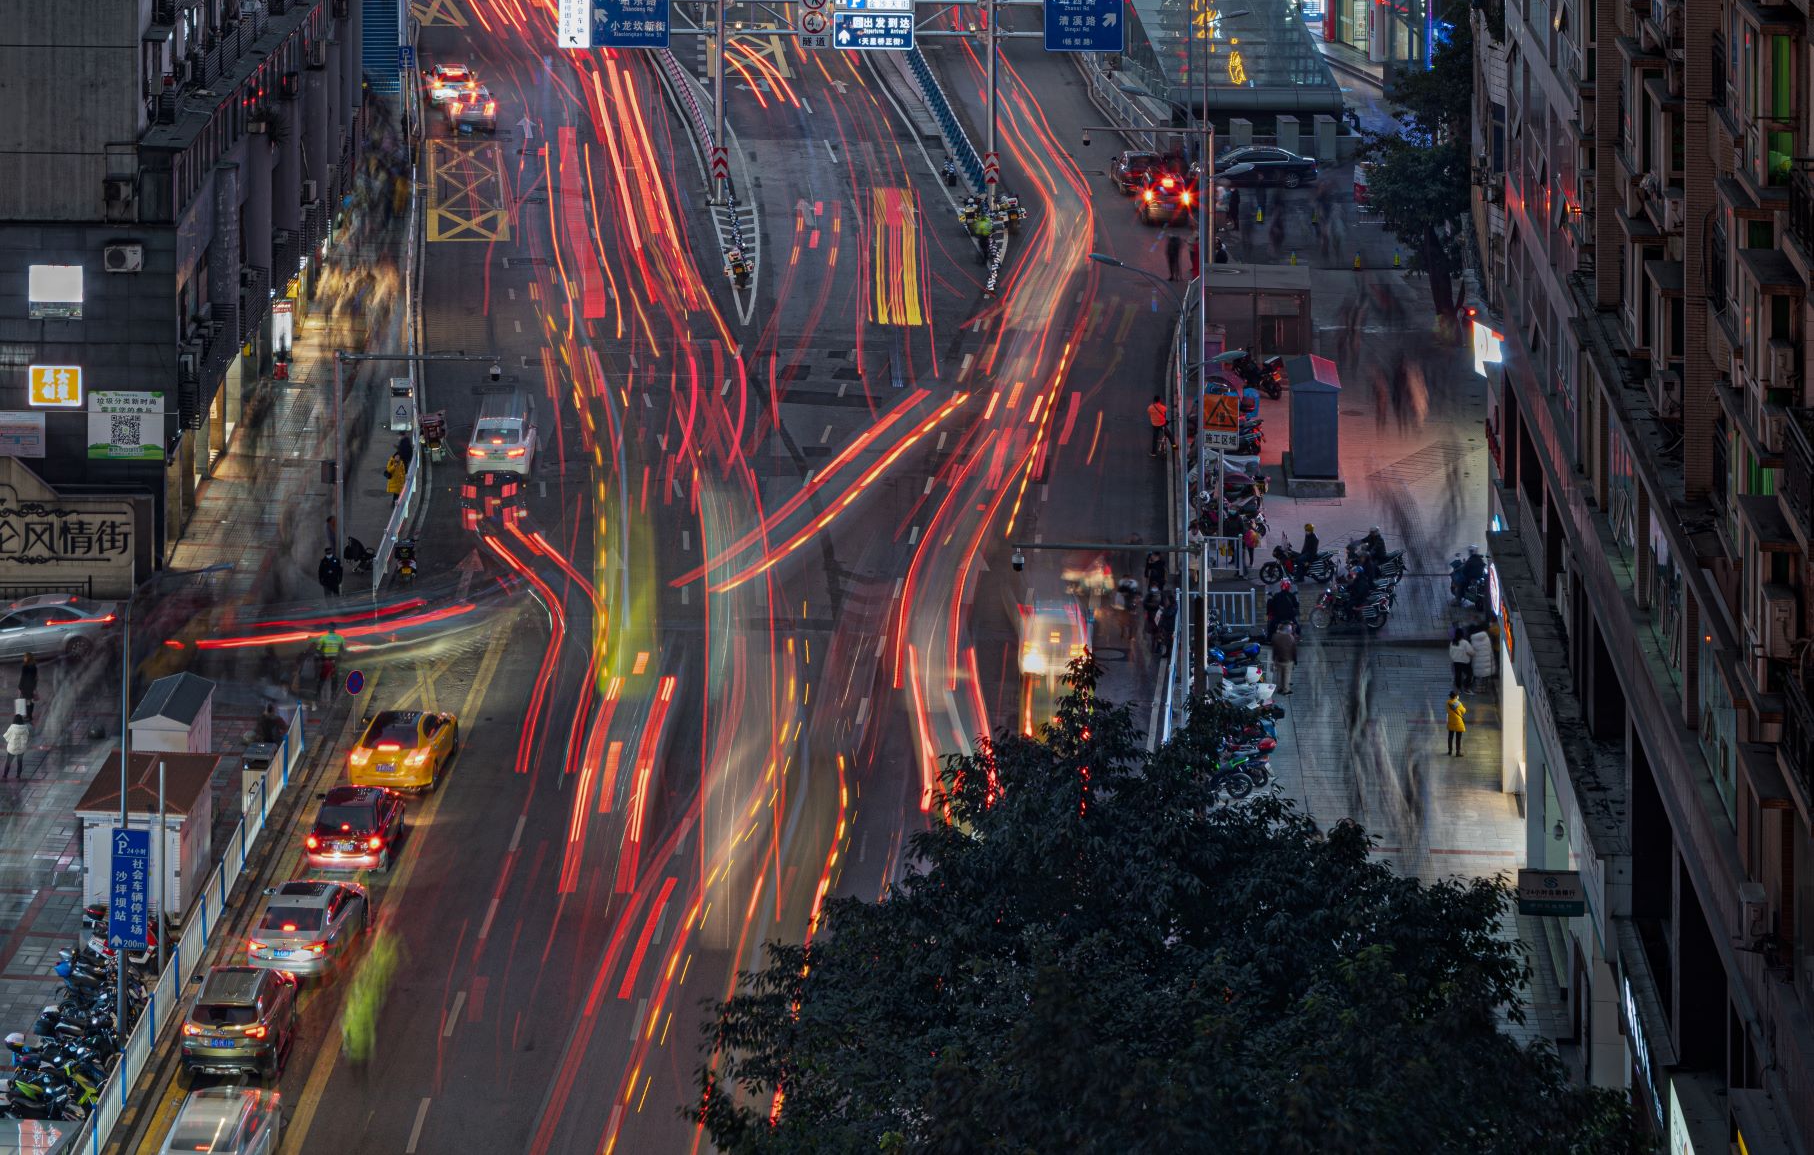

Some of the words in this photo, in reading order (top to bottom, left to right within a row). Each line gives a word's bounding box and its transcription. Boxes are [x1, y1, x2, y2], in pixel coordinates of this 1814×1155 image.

[611, 20, 666, 31] 小龙坎新街
[864, 17, 911, 29] 出发到达
[802, 37, 826, 46] 隧道
[97, 397, 157, 405] 垃圾分类新时尚
[1206, 432, 1237, 446] 施工区域
[126, 848, 147, 856] 24小时
[114, 870, 128, 922] 沙坪坝站
[130, 858, 144, 936] 社会车辆停车场
[123, 939, 146, 949] 200m
